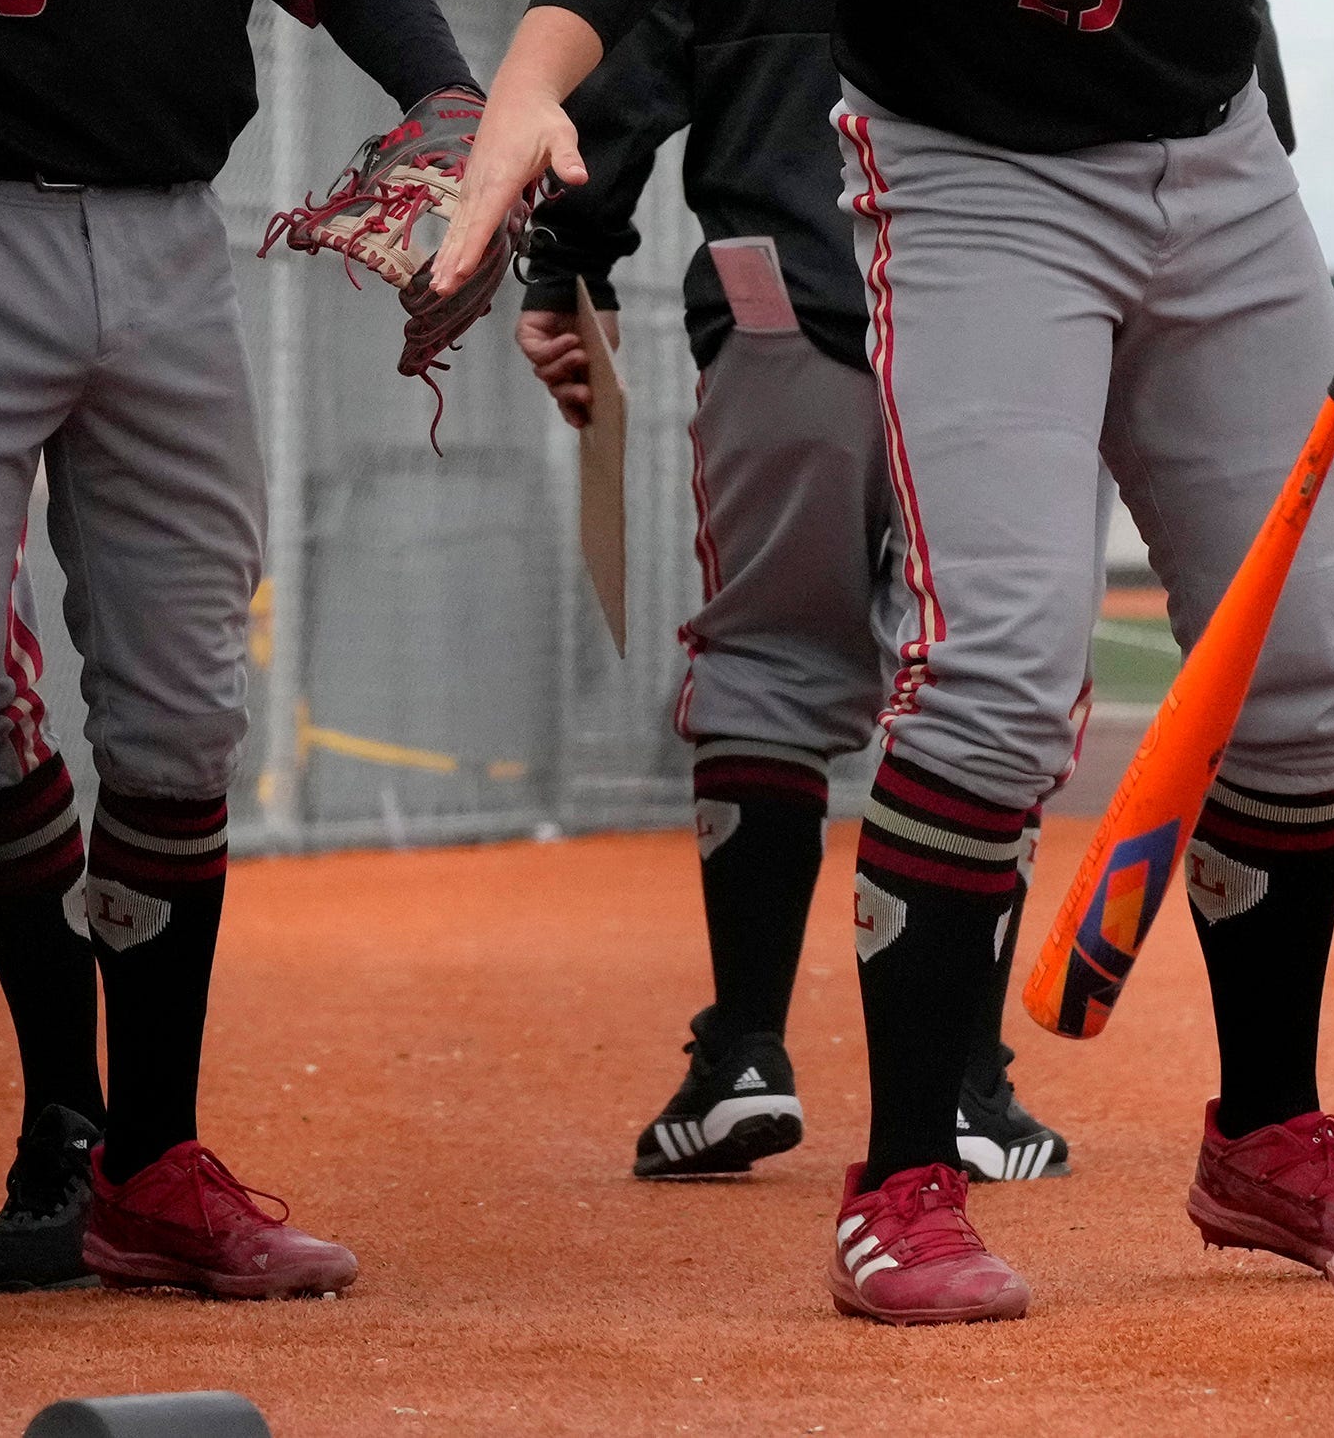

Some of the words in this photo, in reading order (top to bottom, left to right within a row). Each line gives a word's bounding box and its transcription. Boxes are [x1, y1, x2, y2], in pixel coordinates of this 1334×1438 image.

[1190, 853, 1225, 897] L
[98, 892, 134, 929] L
[854, 892, 874, 932] L
